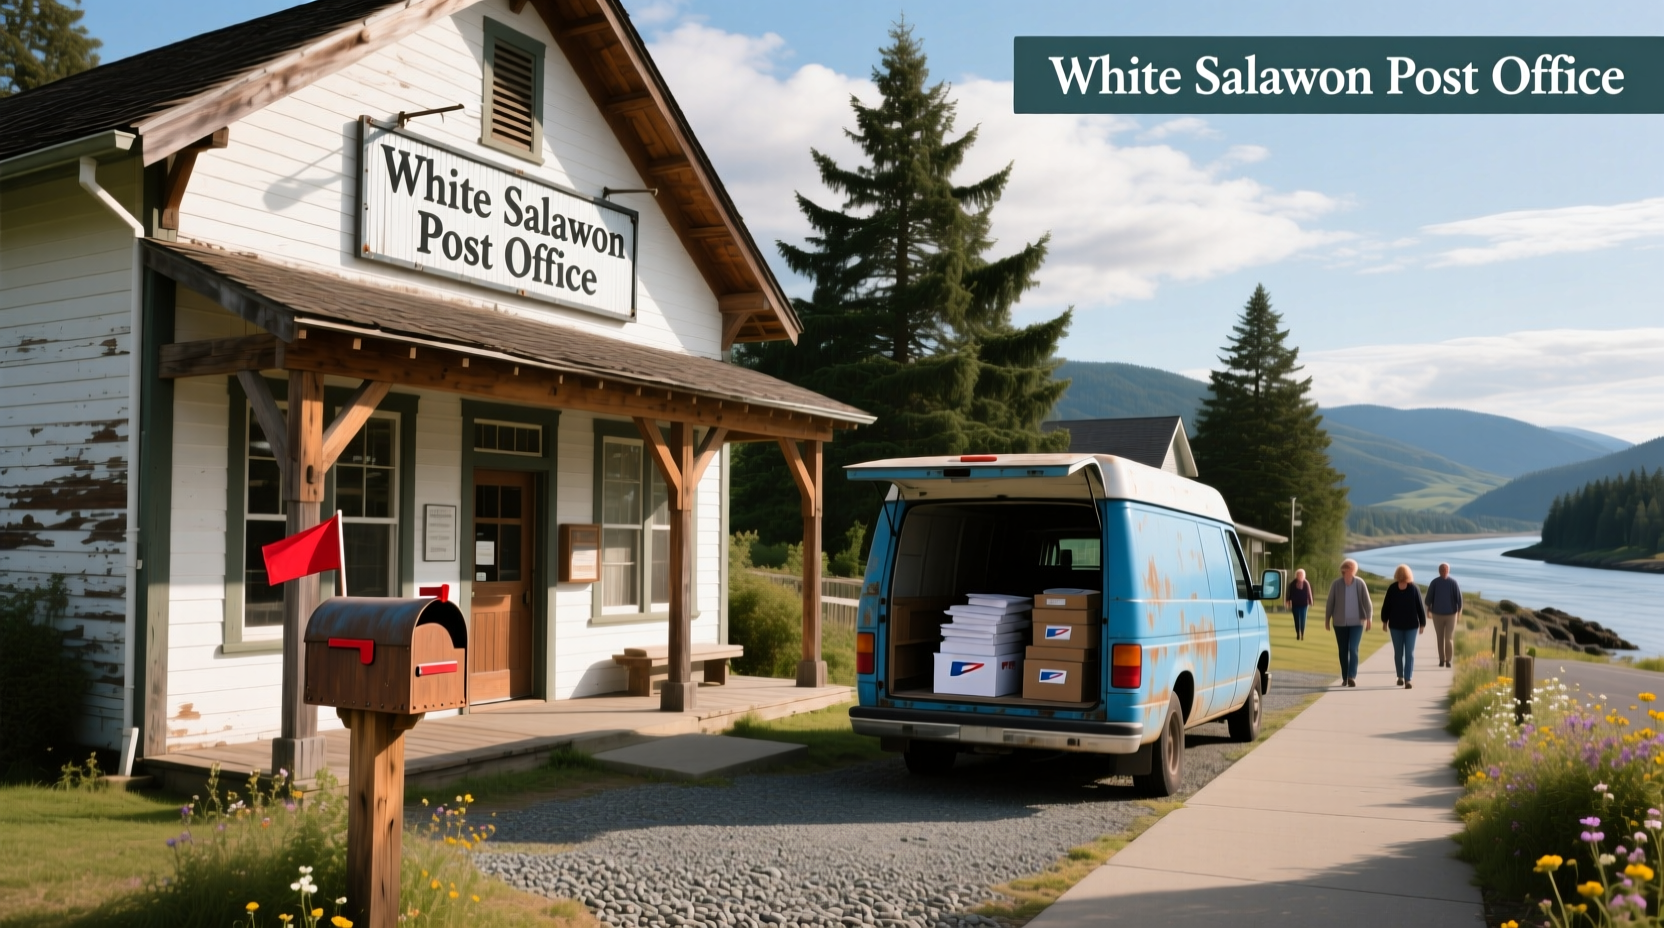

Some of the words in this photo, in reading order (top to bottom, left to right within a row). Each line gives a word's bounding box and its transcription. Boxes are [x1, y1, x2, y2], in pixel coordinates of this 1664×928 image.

[380, 144, 491, 218] White
[504, 186, 625, 259] Salawon
[417, 210, 493, 270] Post
[505, 237, 597, 295] Office
